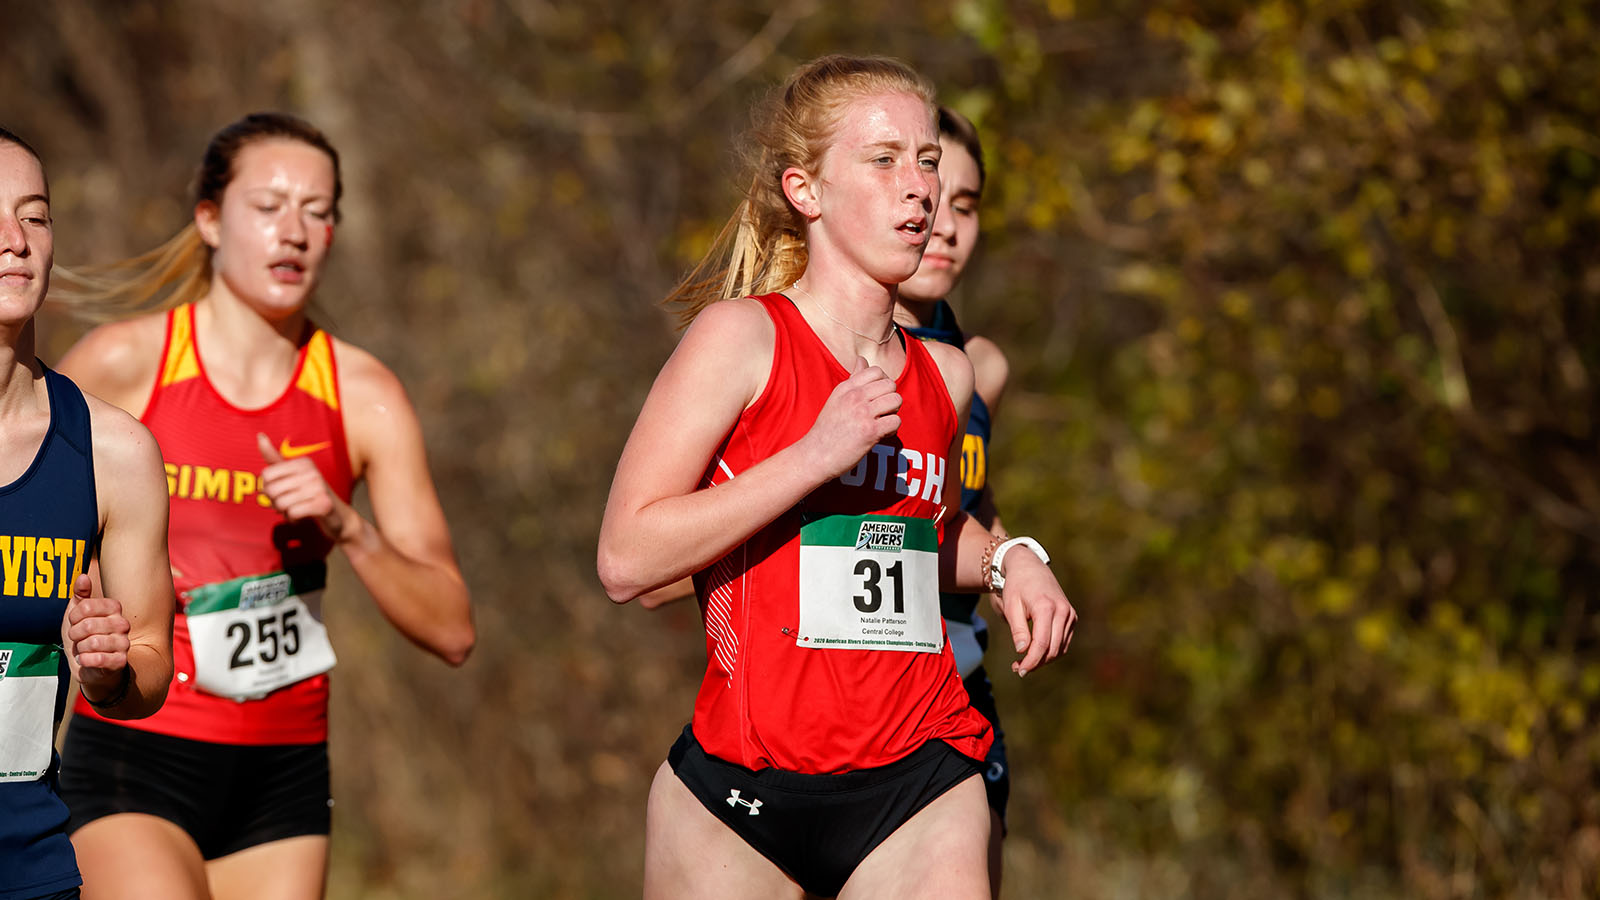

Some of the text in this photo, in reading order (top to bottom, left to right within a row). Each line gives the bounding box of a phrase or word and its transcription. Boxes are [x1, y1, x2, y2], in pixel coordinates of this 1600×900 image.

[840, 443, 946, 505] UTCH
[960, 434, 985, 489] TA
[857, 531, 903, 550] RIVERS
[861, 523, 905, 534] AMERICAN
[0, 535, 86, 599] VISTA
[853, 559, 905, 614] 31
[227, 609, 300, 669] 255
[882, 617, 907, 625] Patterson
[884, 628, 904, 637] College
